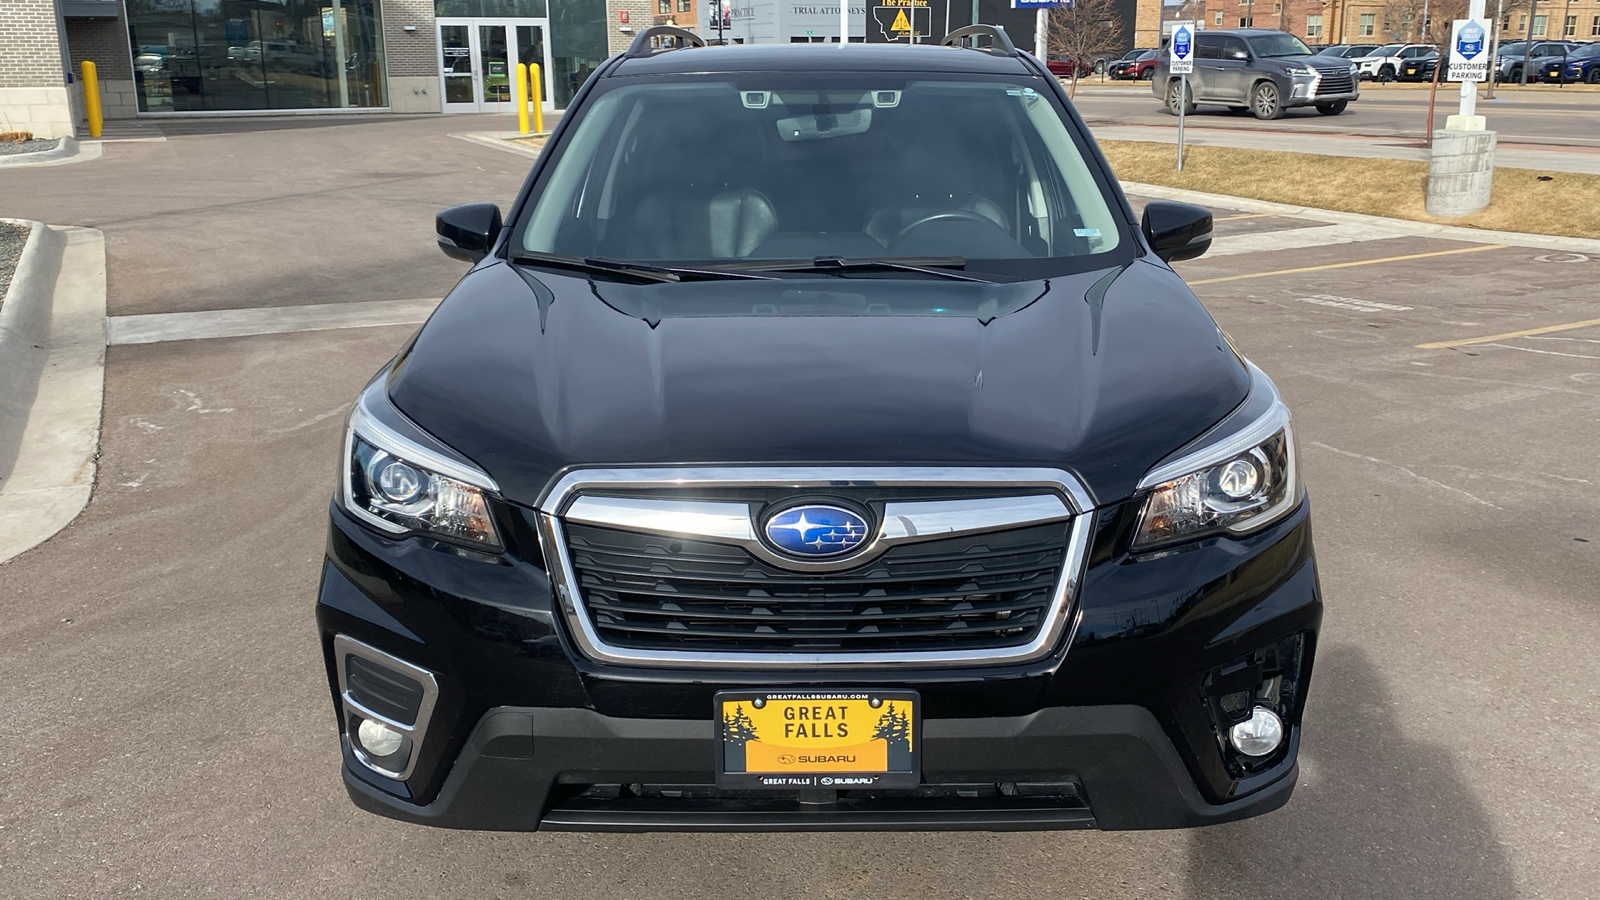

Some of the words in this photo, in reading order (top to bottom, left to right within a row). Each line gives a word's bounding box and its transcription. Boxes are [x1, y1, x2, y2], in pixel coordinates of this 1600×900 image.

[793, 6, 818, 15] TRIAL
[820, 6, 866, 15] ATTONEYS
[783, 706, 849, 721] GREAT
[784, 722, 849, 738] FALLS
[798, 755, 856, 763] SUBARU
[763, 778, 786, 786] GREAT
[788, 778, 810, 786] FALLS
[834, 777, 873, 785] SUBARU
